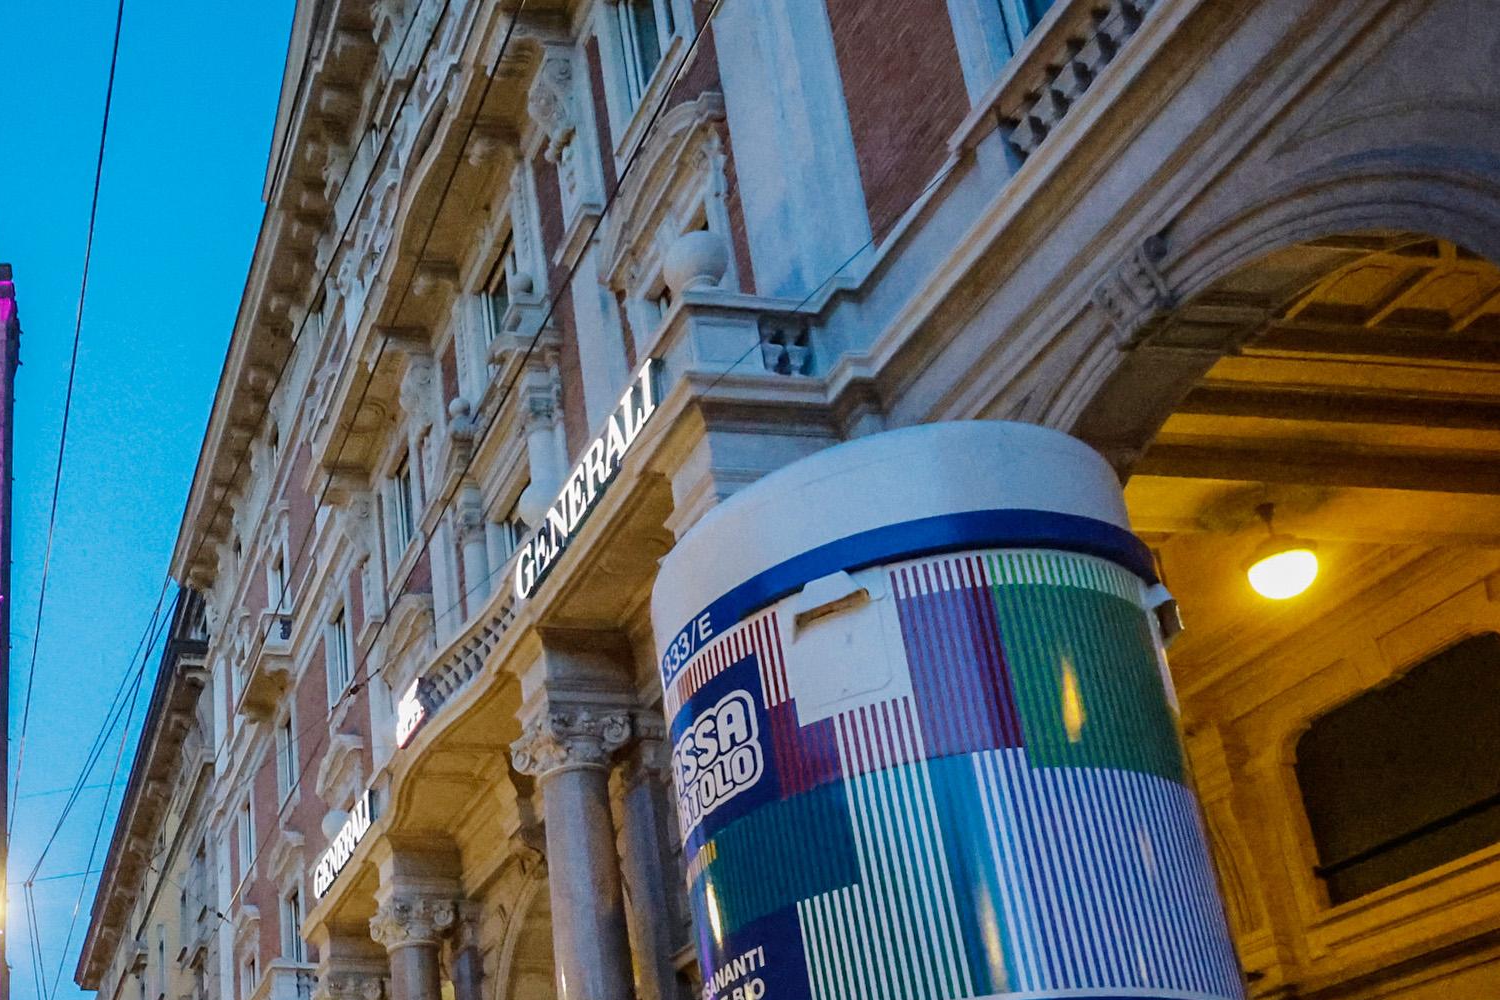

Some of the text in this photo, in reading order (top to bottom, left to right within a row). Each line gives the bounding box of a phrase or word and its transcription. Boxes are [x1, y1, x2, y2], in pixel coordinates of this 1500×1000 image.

[516, 357, 656, 600] GENERALI
[673, 699, 749, 796] ASSA
[314, 788, 373, 899] GENERALI
